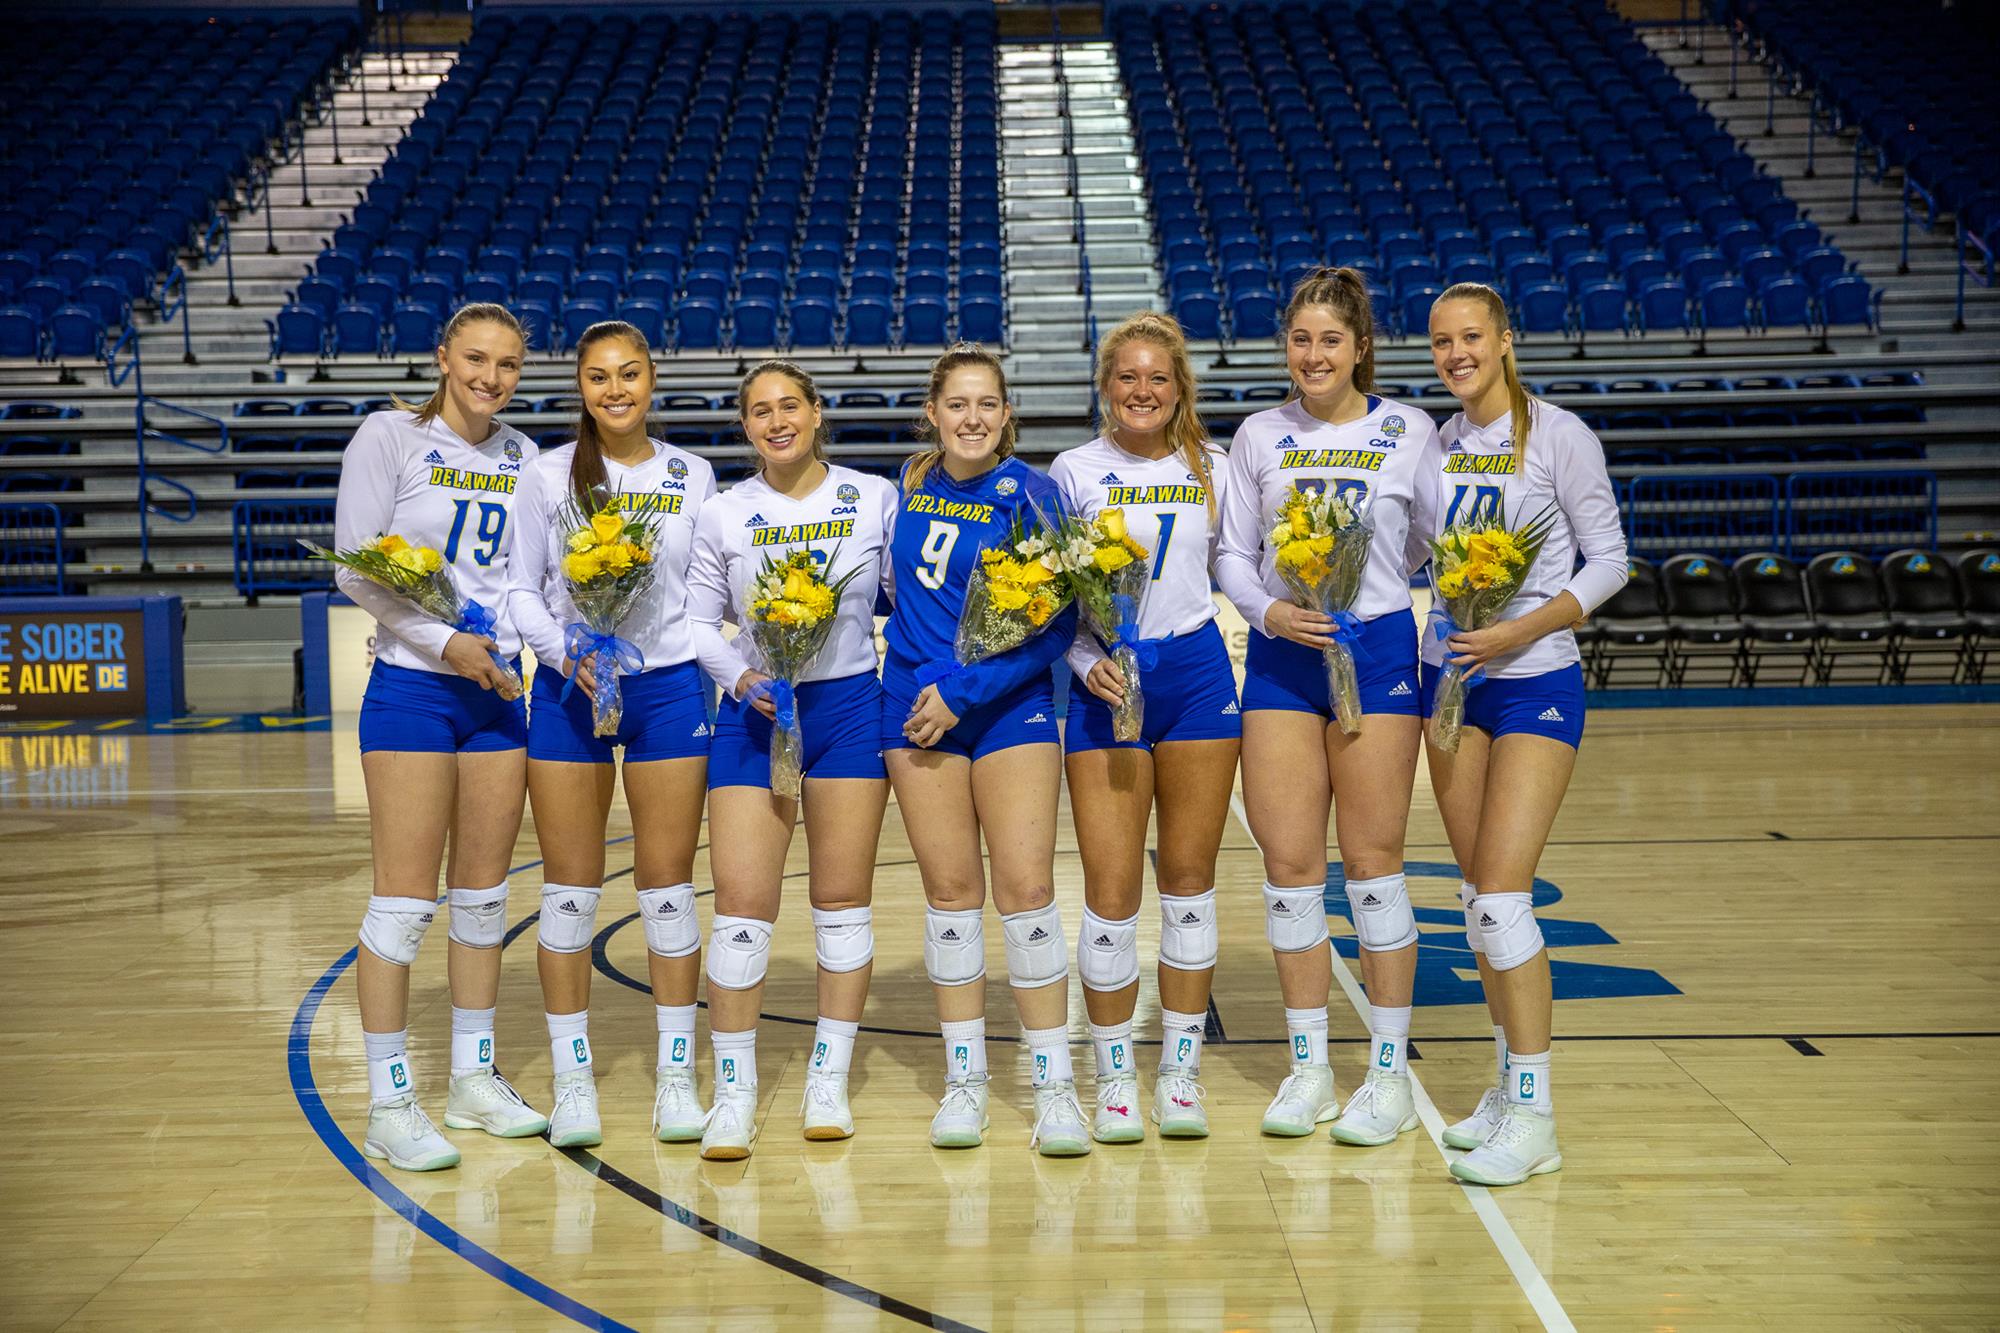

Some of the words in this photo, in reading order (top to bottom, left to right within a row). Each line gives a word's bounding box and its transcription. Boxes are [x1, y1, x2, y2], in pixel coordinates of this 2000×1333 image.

[1369, 438, 1397, 449] CAA
[1279, 448, 1387, 472] DELAWARE
[1442, 453, 1517, 475] DELAWARE
[429, 465, 517, 495] DELAWARE
[662, 480, 686, 491] CAA
[617, 492, 683, 515] AWARE
[1107, 485, 1207, 506] DELAWARE
[831, 506, 857, 515] CAA
[906, 494, 995, 524] DELAWARE
[444, 498, 509, 569] 19
[752, 518, 855, 547] DELAWARE
[915, 519, 961, 591] 9
[1150, 512, 1177, 582] 1
[21, 623, 125, 662] SOBER
[19, 663, 90, 694] ALIVE
[98, 665, 126, 688] DE
[1538, 714, 1564, 722] adidas
